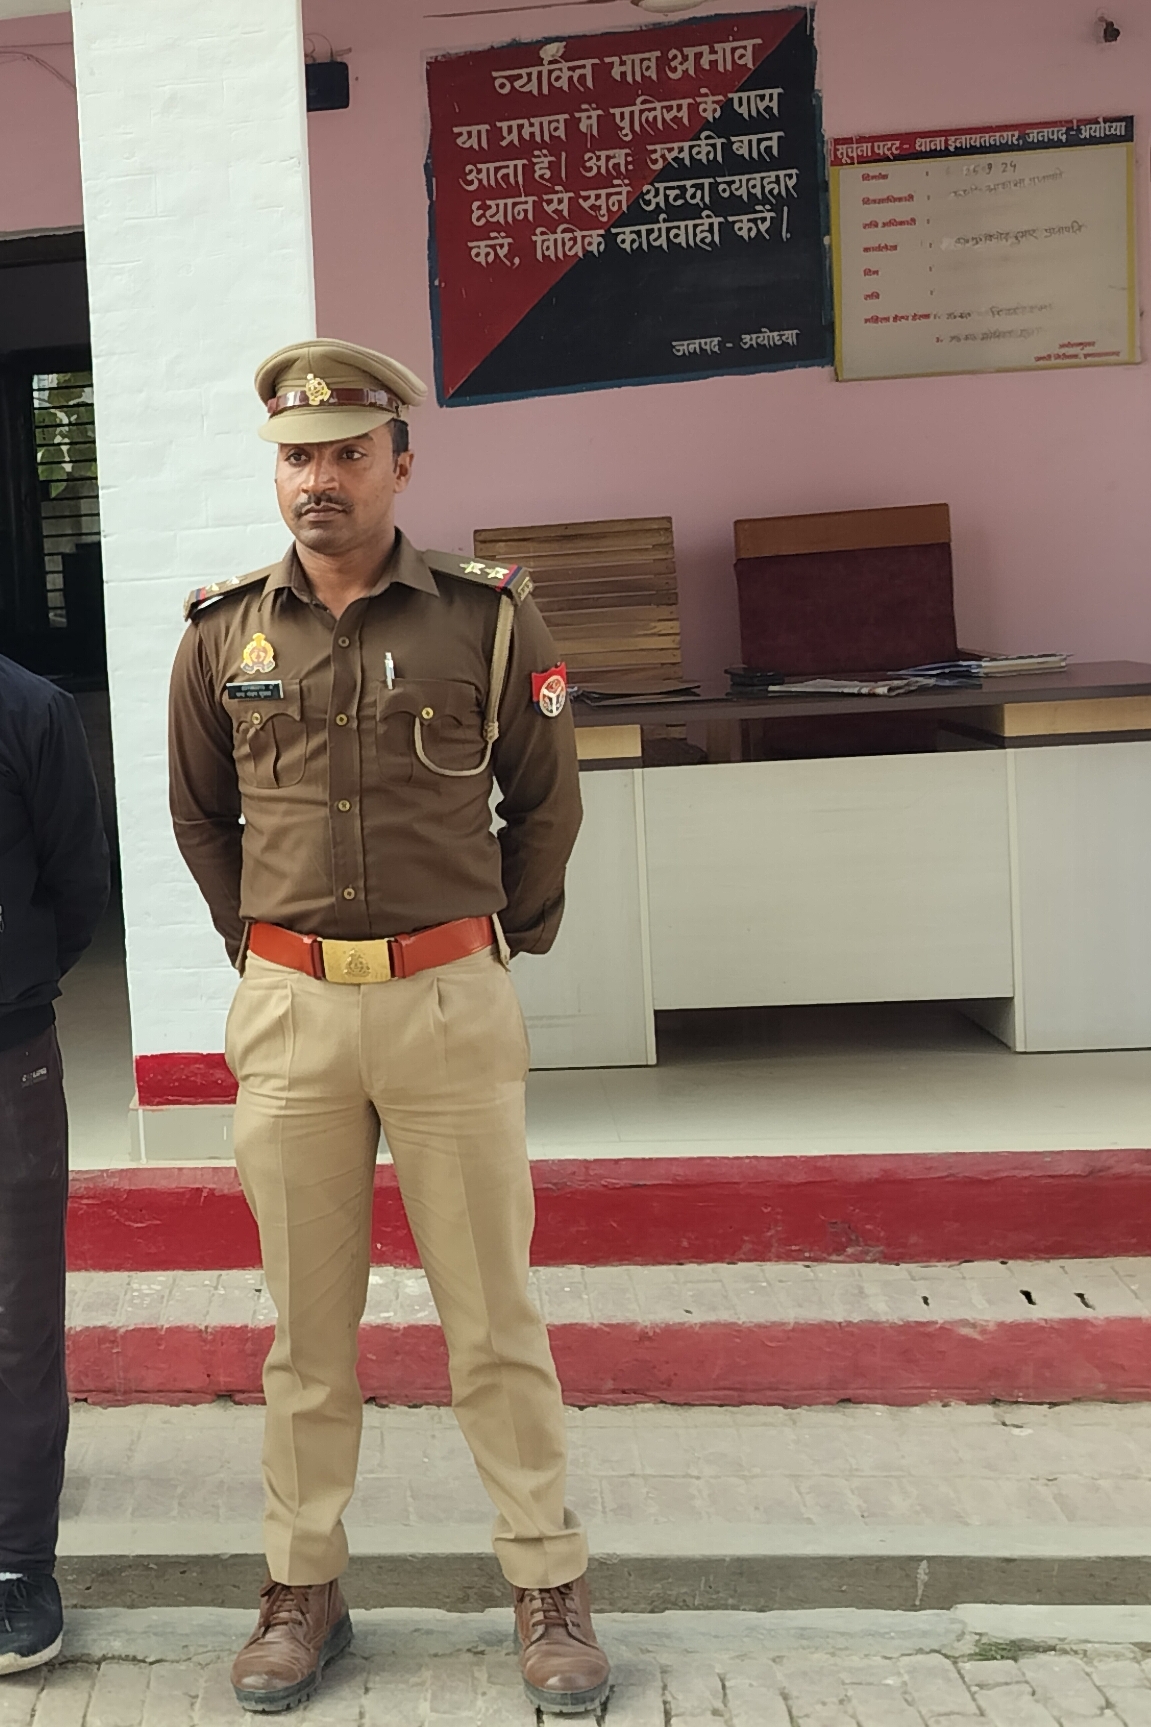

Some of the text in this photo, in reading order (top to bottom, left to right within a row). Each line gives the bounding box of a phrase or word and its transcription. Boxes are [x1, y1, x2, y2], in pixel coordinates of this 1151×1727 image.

[491, 56, 600, 97] व्यक्ति
[604, 50, 661, 85] भाव
[452, 88, 785, 151] या प्रभाव में पुलिस के पास
[836, 142, 871, 163] सूचना
[874, 140, 901, 159] पट्ट
[915, 136, 946, 152] थाना
[947, 130, 1023, 152] इनायतनगर,
[1025, 126, 1067, 144] जनपद
[1078, 120, 1126, 140] अयोध्या
[459, 159, 529, 192] आता
[580, 148, 634, 178] अतः
[646, 130, 727, 170] उसकी
[730, 131, 785, 162] बात
[471, 168, 799, 227] ध्यान से सुनें अच्छा व्यवहार
[467, 231, 520, 269] करें,
[532, 223, 605, 263] विधिक
[611, 209, 725, 255] कार्यवाही
[671, 336, 722, 356] जनपद
[740, 328, 800, 349] अयोध्या
